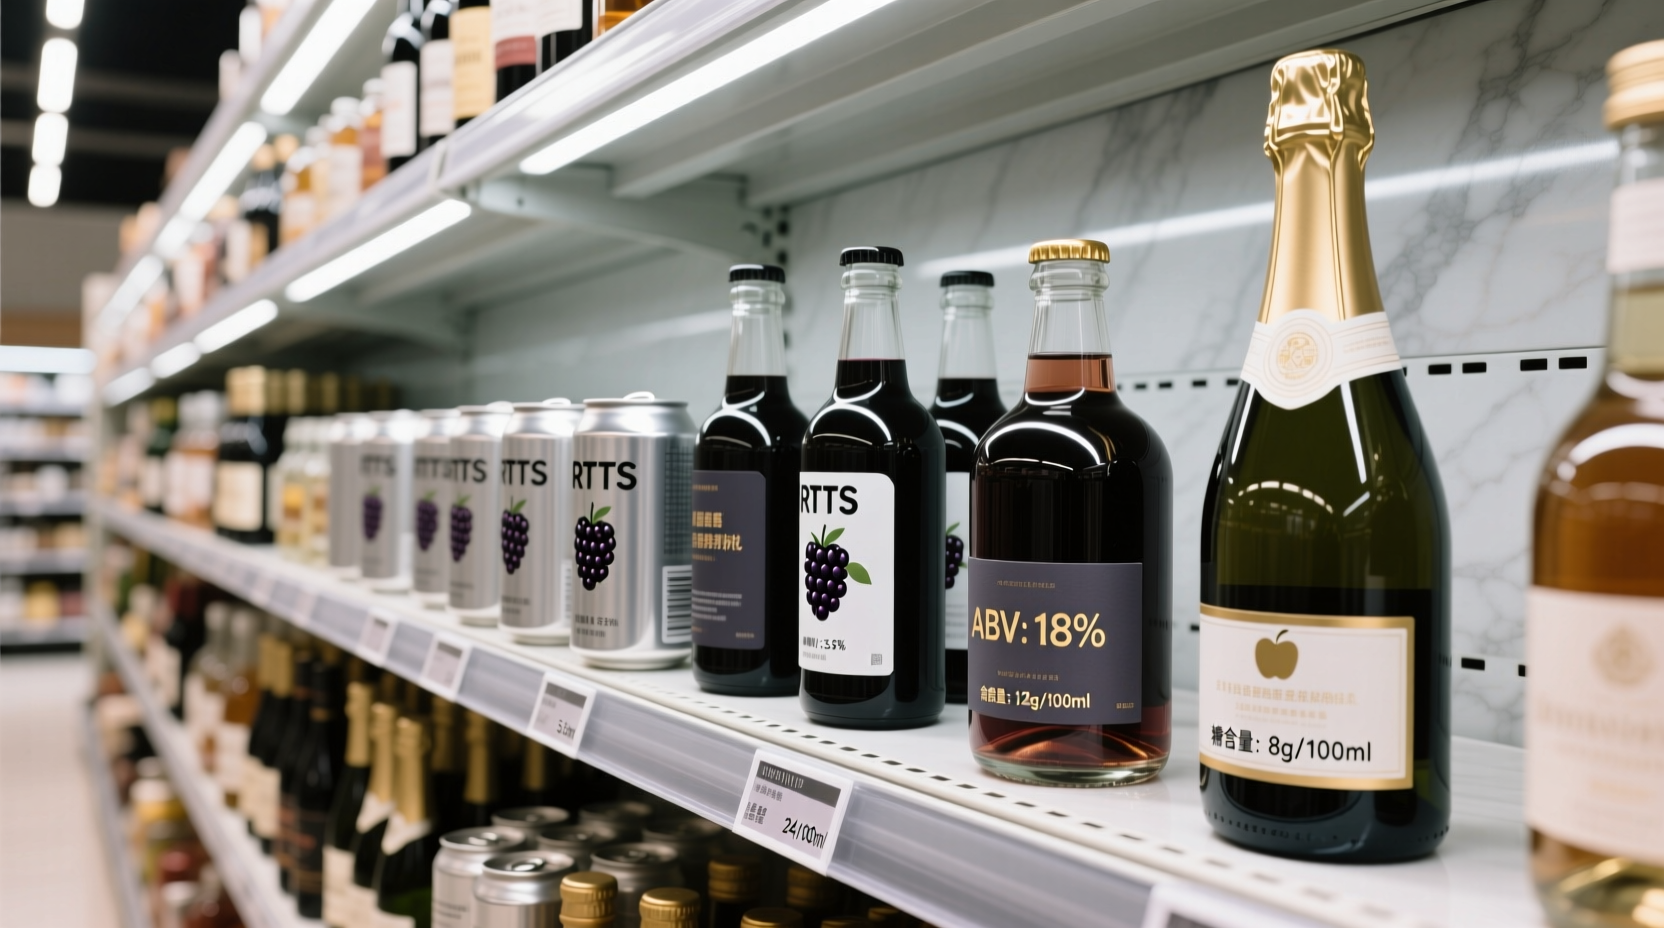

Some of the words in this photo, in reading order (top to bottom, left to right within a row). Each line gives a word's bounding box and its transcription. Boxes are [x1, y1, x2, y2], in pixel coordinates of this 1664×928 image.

[572, 460, 637, 491] RTTS
[800, 484, 858, 515] RTTS
[971, 606, 1028, 645] ABV:
[1034, 612, 1106, 648] 18%
[1015, 690, 1091, 711] 12g/100ml
[1268, 735, 1371, 763] 8g/100ml
